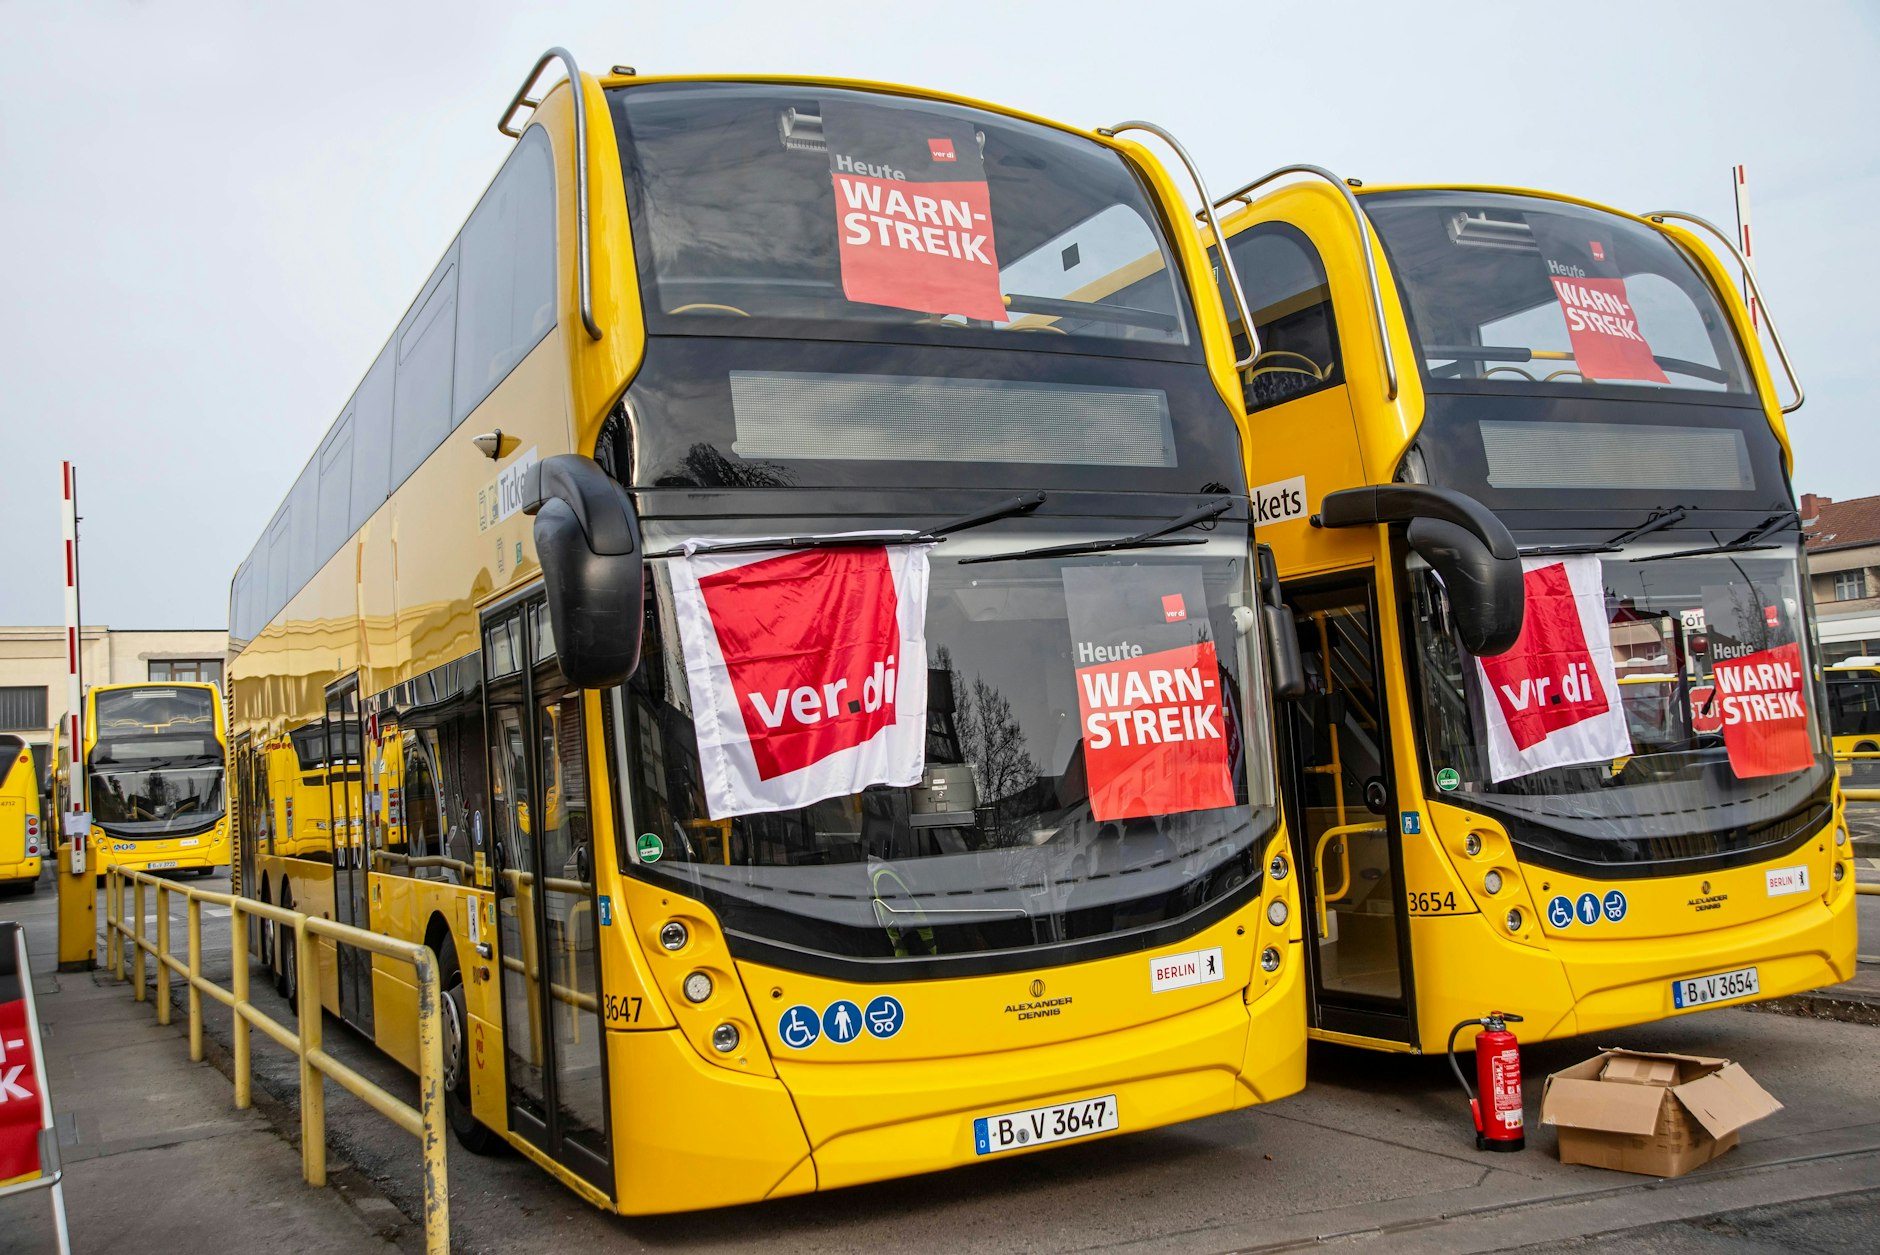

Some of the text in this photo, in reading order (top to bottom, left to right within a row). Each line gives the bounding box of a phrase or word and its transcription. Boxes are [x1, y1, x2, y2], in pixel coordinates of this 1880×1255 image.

[836, 154, 906, 181] Heute
[839, 178, 986, 229] WARN-
[844, 213, 992, 265] STREIK
[1547, 260, 1586, 279] Heute
[1554, 280, 1630, 316] WARN-
[1566, 307, 1644, 342] STREIK
[501, 463, 529, 515] Ticke
[1253, 488, 1301, 523] kets
[1078, 640, 1143, 663] Heute
[1713, 643, 1754, 660] Heute
[1081, 667, 1215, 708] WARN-
[1715, 661, 1800, 694] WARN-
[1722, 690, 1805, 725] STREIK
[1086, 704, 1221, 749] STREIK
[1769, 876, 1793, 888] BERLIN
[1408, 892, 1456, 912] 3654
[1687, 894, 1727, 906] ALEXANDER
[1695, 903, 1721, 912] DENNIS
[1156, 963, 1196, 981] BERLIN
[1687, 983, 1698, 1002] B
[1706, 979, 1716, 998] V
[1720, 971, 1753, 995] 3654
[605, 993, 642, 1023] 3647
[1004, 996, 1073, 1014] ALEXANDER
[1018, 1008, 1061, 1021] DENNIS
[998, 1120, 1015, 1145] B
[1031, 1112, 1045, 1139] V
[1052, 1101, 1107, 1136] 3647
